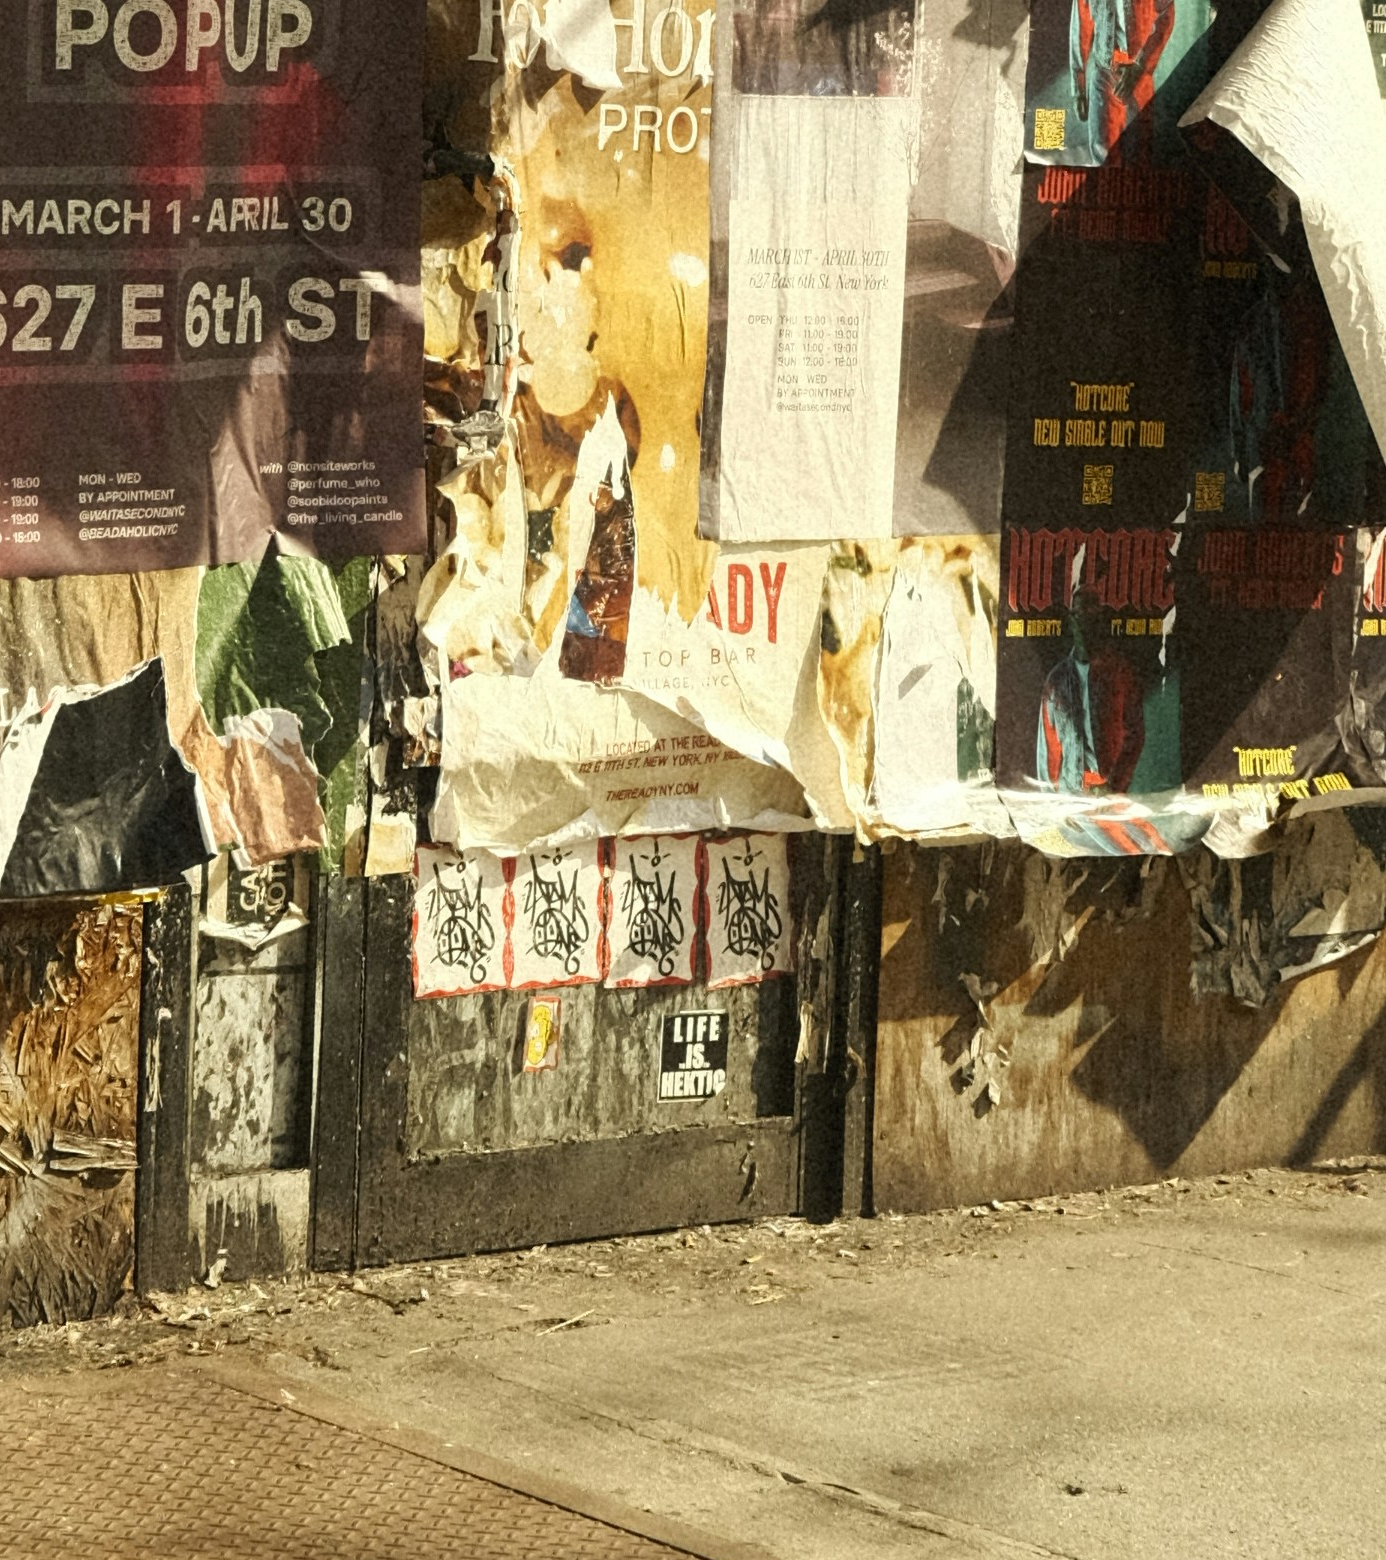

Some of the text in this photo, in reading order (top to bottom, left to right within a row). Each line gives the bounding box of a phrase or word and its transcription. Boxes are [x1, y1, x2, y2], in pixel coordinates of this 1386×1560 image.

[597, 104, 711, 154] PRO
[1, 196, 352, 235] MARCH 1 APRIL 30
[748, 248, 791, 266] MARCH
[121, 283, 165, 350] E
[184, 278, 263, 348] 6th
[286, 277, 389, 343] ST
[1034, 418, 1060, 447] NEW
[1065, 419, 1106, 447] SINGLE
[1111, 420, 1135, 448] OUT
[79, 473, 141, 485] MON WED
[260, 463, 282, 474] with
[79, 489, 175, 503] BY APPOINTMENT
[1008, 528, 1176, 612] HOTCORE
[711, 648, 756, 664] BAR
[607, 736, 689, 757] LOCATED AT THE
[644, 756, 668, 768] NEW
[606, 782, 699, 802] THEREADYNY.COM
[674, 1015, 720, 1043] LIFE
[661, 1069, 725, 1097] HEKTIC
